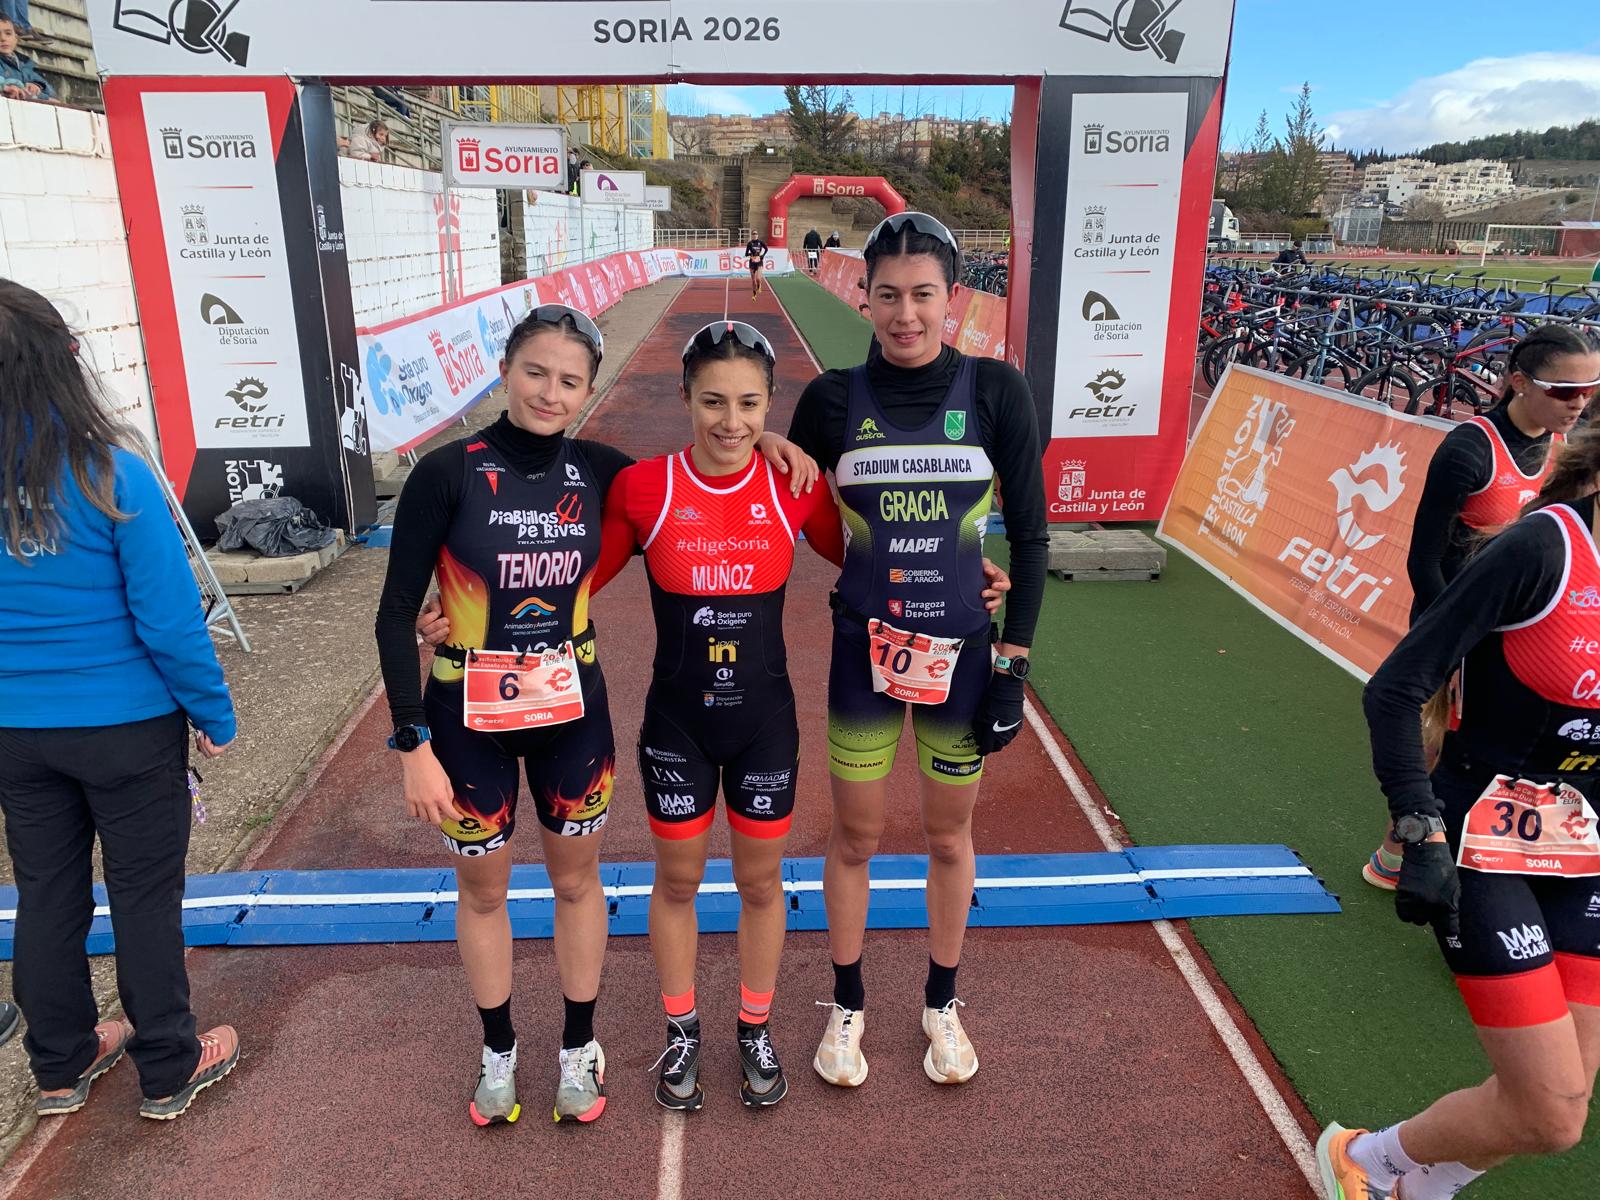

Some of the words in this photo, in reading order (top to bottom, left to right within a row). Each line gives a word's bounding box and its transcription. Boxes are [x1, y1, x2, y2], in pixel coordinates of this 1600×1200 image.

[594, 16, 693, 44] SORIA
[703, 16, 781, 42] 2026
[186, 135, 257, 159] Soria
[504, 146, 559, 154] AYUNTAMIENTO
[1105, 130, 1170, 154] Soria
[484, 147, 559, 174] Soria
[826, 181, 865, 196] Soria
[213, 234, 250, 245] Junta
[253, 234, 269, 245] de
[1107, 233, 1142, 245] Junta
[1145, 232, 1161, 244] de
[180, 248, 226, 259] Castilla
[228, 250, 236, 261] y
[240, 247, 272, 258] León
[1074, 246, 1116, 259] Castilla
[1119, 249, 1128, 260] y
[1129, 245, 1160, 257] León
[218, 327, 270, 338] Diputación
[1094, 322, 1142, 333] Diputación
[219, 336, 232, 345] de
[233, 335, 258, 345] Soria
[1093, 332, 1104, 341] de
[1106, 331, 1129, 341] Soria
[853, 458, 900, 476] STADIUM
[902, 457, 972, 474] CASABLANCA
[1088, 489, 1125, 500] Junta
[1129, 488, 1146, 499] de
[879, 489, 950, 522] GRACIA
[1050, 501, 1096, 513] Castilla
[1100, 504, 1107, 516] y
[1112, 500, 1145, 512] León
[1218, 495, 1258, 528] CASTILLA
[1222, 519, 1248, 547] LEÓN
[676, 535, 770, 556] #eligeSoria
[497, 550, 582, 589] TENORIO
[692, 559, 755, 591] MUÑOZ
[905, 599, 946, 610] Zaragoza
[717, 611, 736, 619] Soria
[737, 611, 753, 619] puro
[1308, 607, 1319, 619] DE
[1325, 599, 1361, 627] ESPAÑOLA
[876, 642, 912, 675] 10
[499, 672, 520, 701] 6
[893, 687, 920, 698] SORIA
[523, 711, 554, 723] SORIA
[656, 792, 695, 808] MAD
[1490, 801, 1543, 842] 30
[1525, 858, 1563, 869] SORIA
[1496, 922, 1545, 950] MAD
